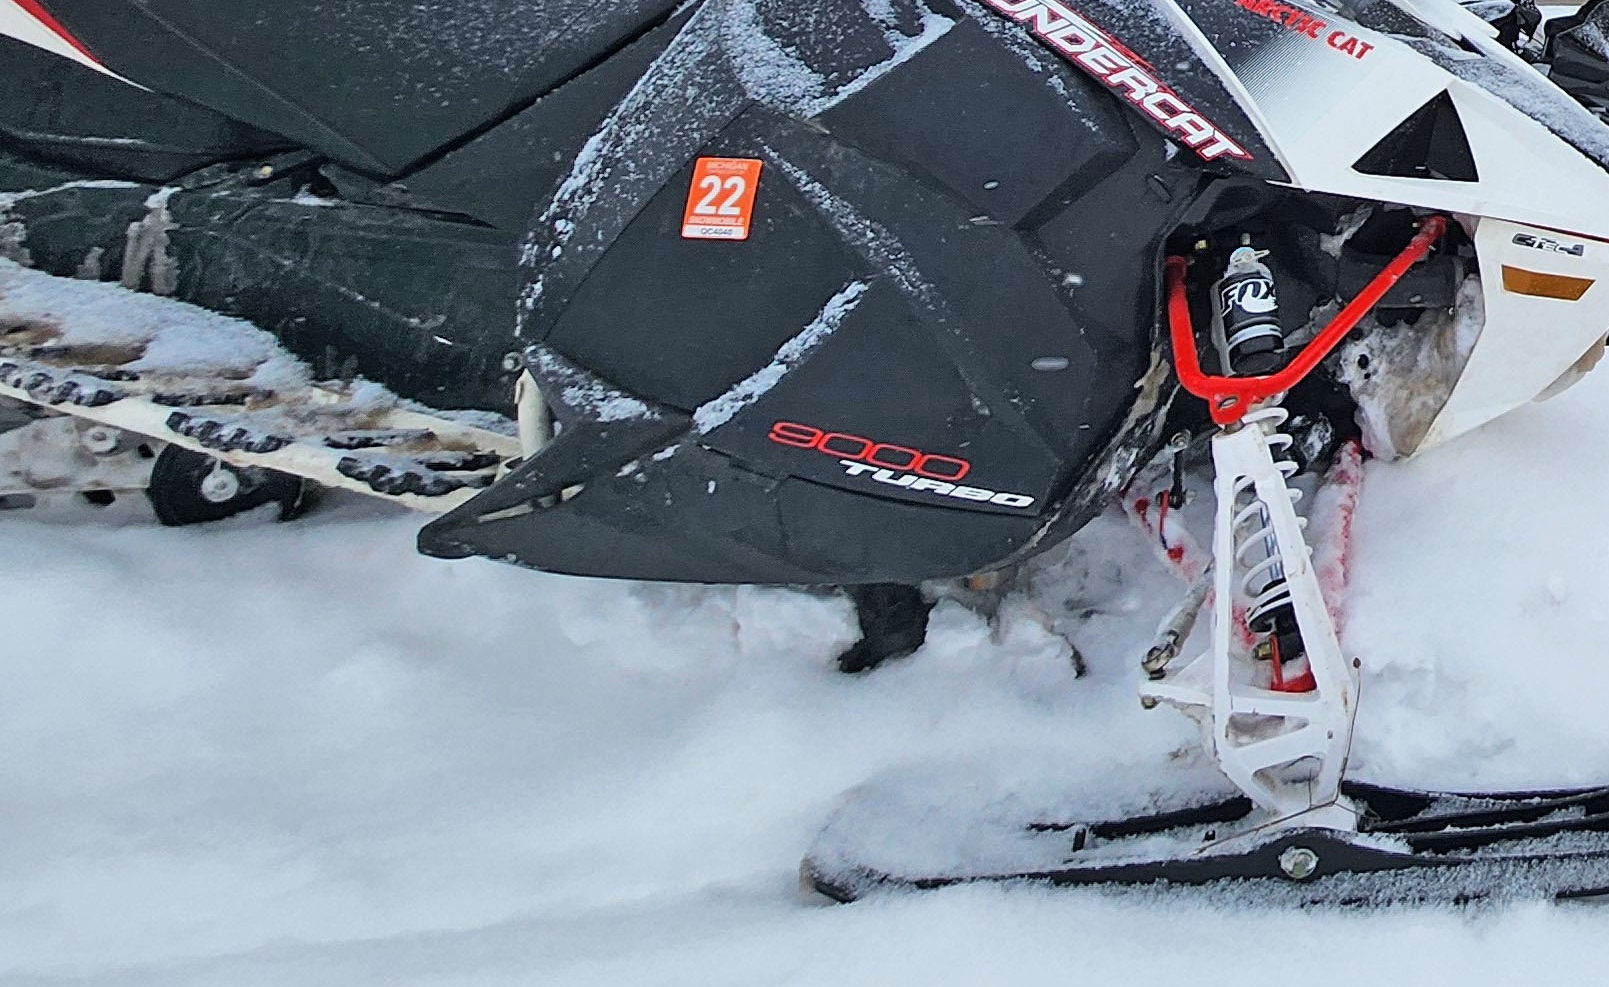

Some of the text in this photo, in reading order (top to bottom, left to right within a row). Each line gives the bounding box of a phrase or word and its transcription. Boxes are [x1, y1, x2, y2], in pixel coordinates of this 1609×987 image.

[1327, 30, 1375, 60] CAT
[693, 174, 746, 216] 22
[1221, 278, 1278, 317] FOX
[767, 421, 971, 482] 9000
[839, 459, 1036, 508] TURBO
